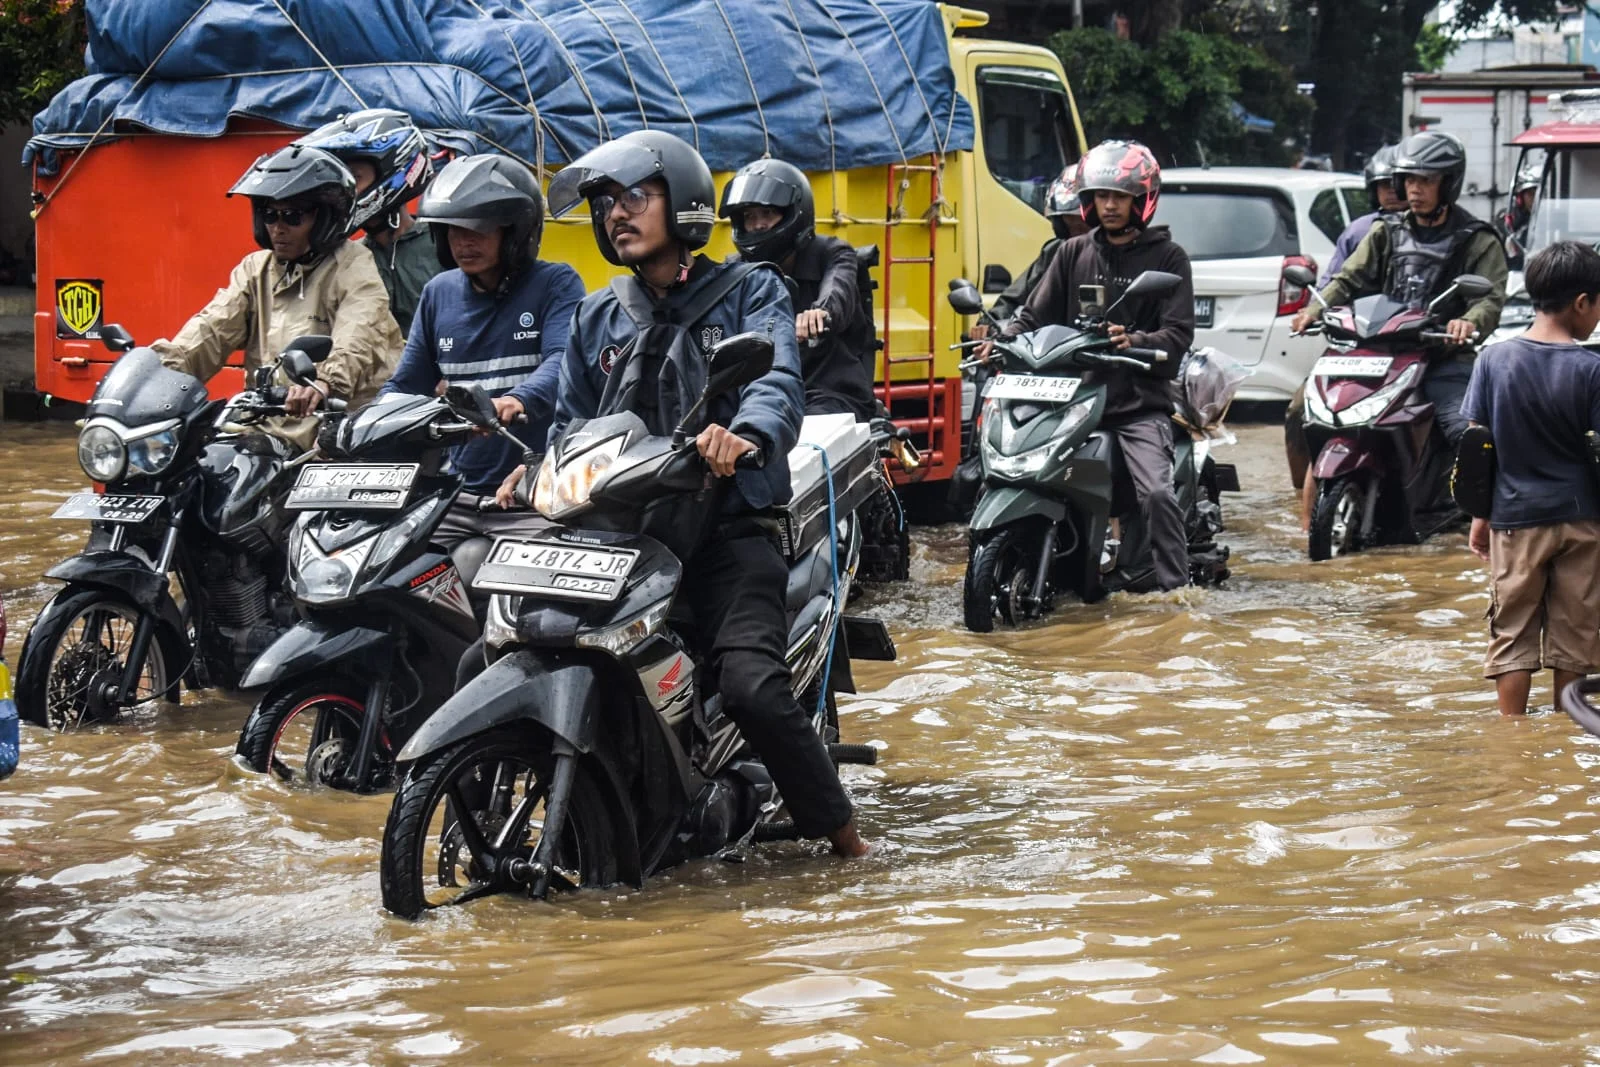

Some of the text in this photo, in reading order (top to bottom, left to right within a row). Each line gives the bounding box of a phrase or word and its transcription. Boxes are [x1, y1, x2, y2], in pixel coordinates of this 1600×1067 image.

[64, 286, 93, 329] TGH
[996, 376, 1006, 386] D
[302, 471, 316, 487] D
[68, 496, 81, 506] D
[497, 546, 629, 575] D 4874 JR
[410, 562, 448, 588] HONDA
